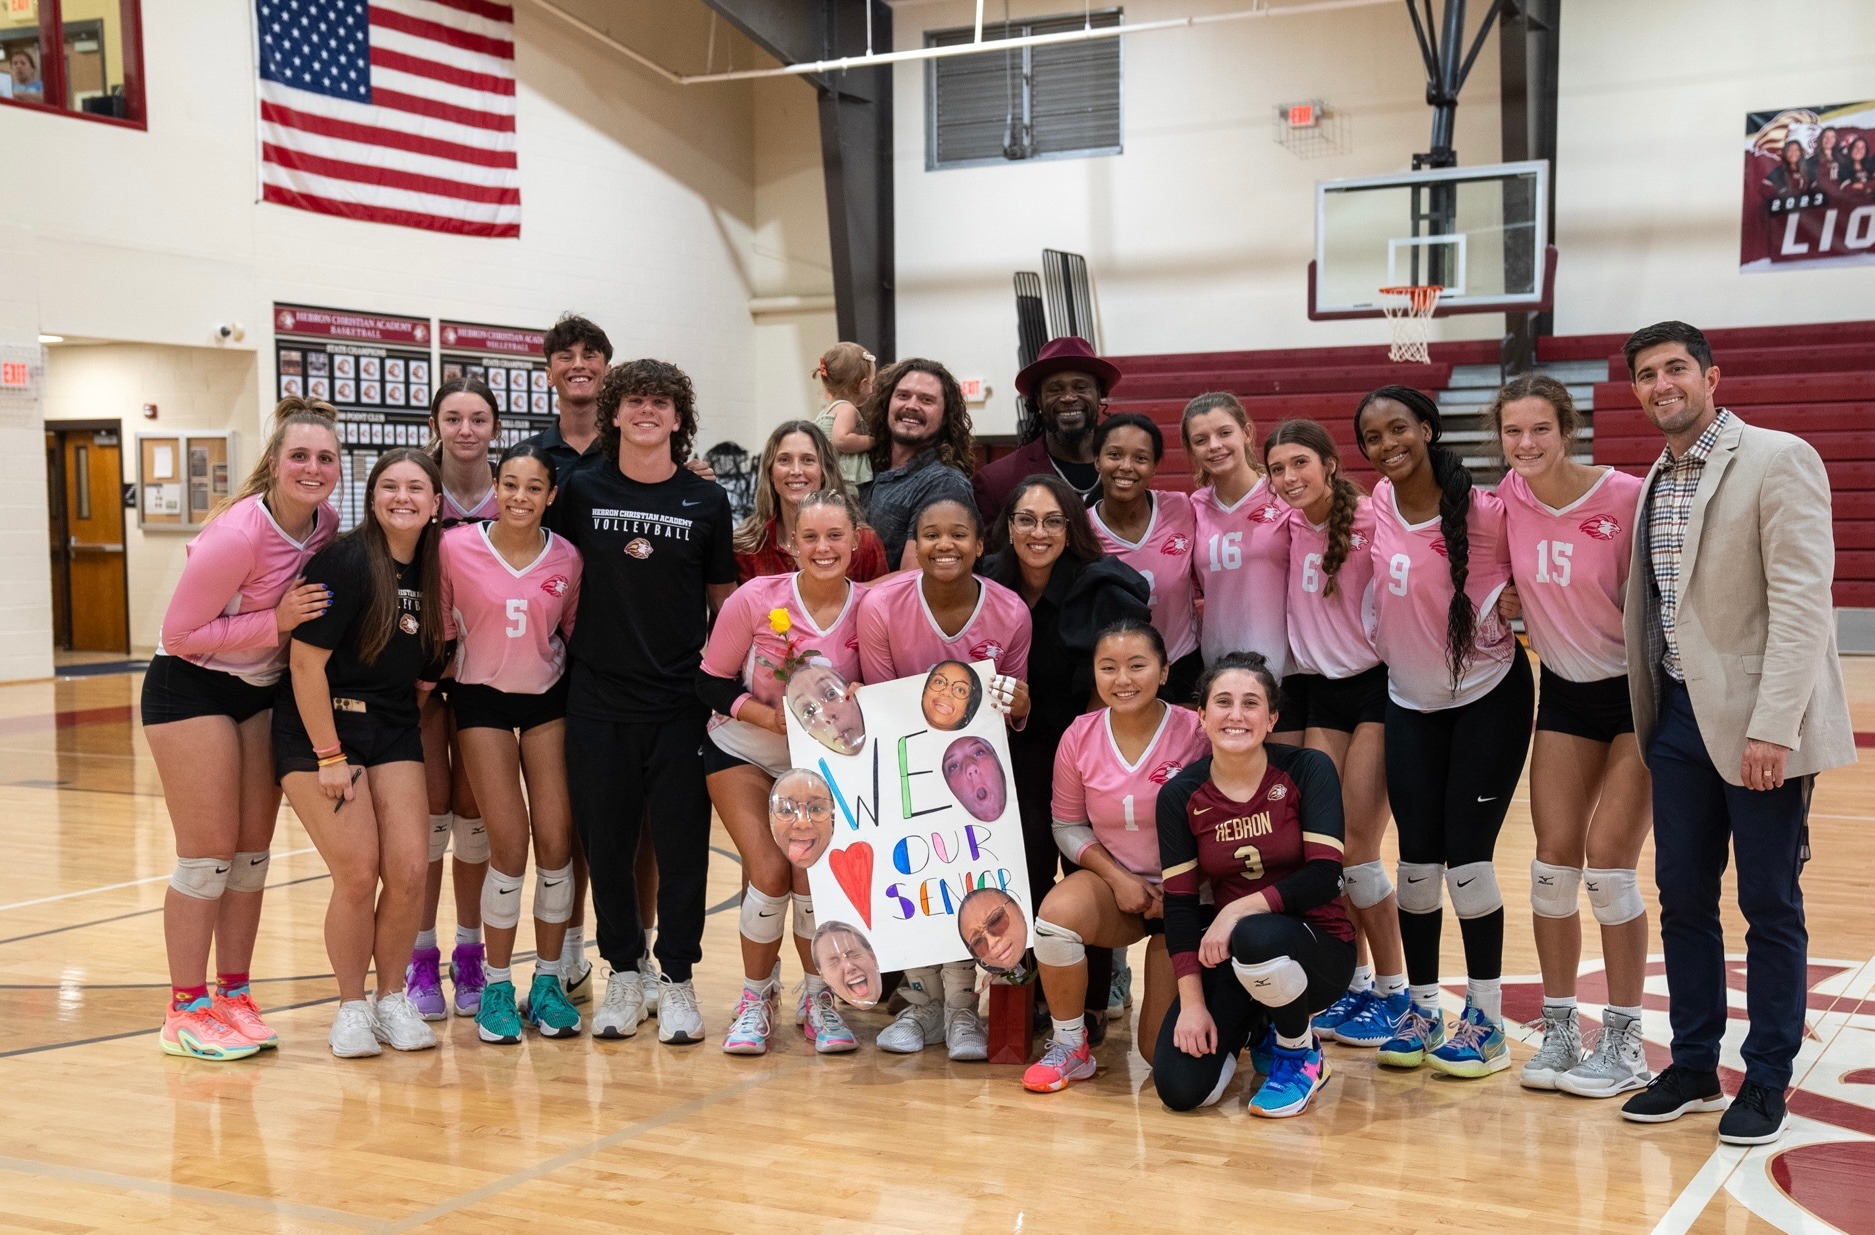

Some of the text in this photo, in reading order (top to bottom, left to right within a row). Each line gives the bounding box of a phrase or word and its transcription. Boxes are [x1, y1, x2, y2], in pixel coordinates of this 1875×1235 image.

[1771, 193, 1824, 212] 2023
[1780, 205, 1875, 255] LIO
[296, 311, 412, 332] HEBRON CHRISTIAN ACADEMY
[330, 325, 382, 339] BASKETBALL
[457, 328, 487, 339] HEBRON
[488, 331, 523, 343] CHRISTIAN
[486, 340, 529, 352] VOLLEYBALL
[3, 362, 27, 384] EXIT
[592, 508, 693, 527] HEBRON CHRISTIAN ACADEMY
[593, 518, 690, 541] VOLLEYBALL
[1209, 531, 1243, 572] 16
[1536, 539, 1574, 587] 15
[1302, 553, 1321, 593] 6
[1389, 553, 1411, 597] 9
[505, 598, 528, 638] 5
[818, 729, 953, 831] WE
[1122, 794, 1139, 832] 1
[1215, 810, 1273, 843] HEBRON
[893, 824, 999, 875] OUR
[1233, 844, 1266, 881] 3
